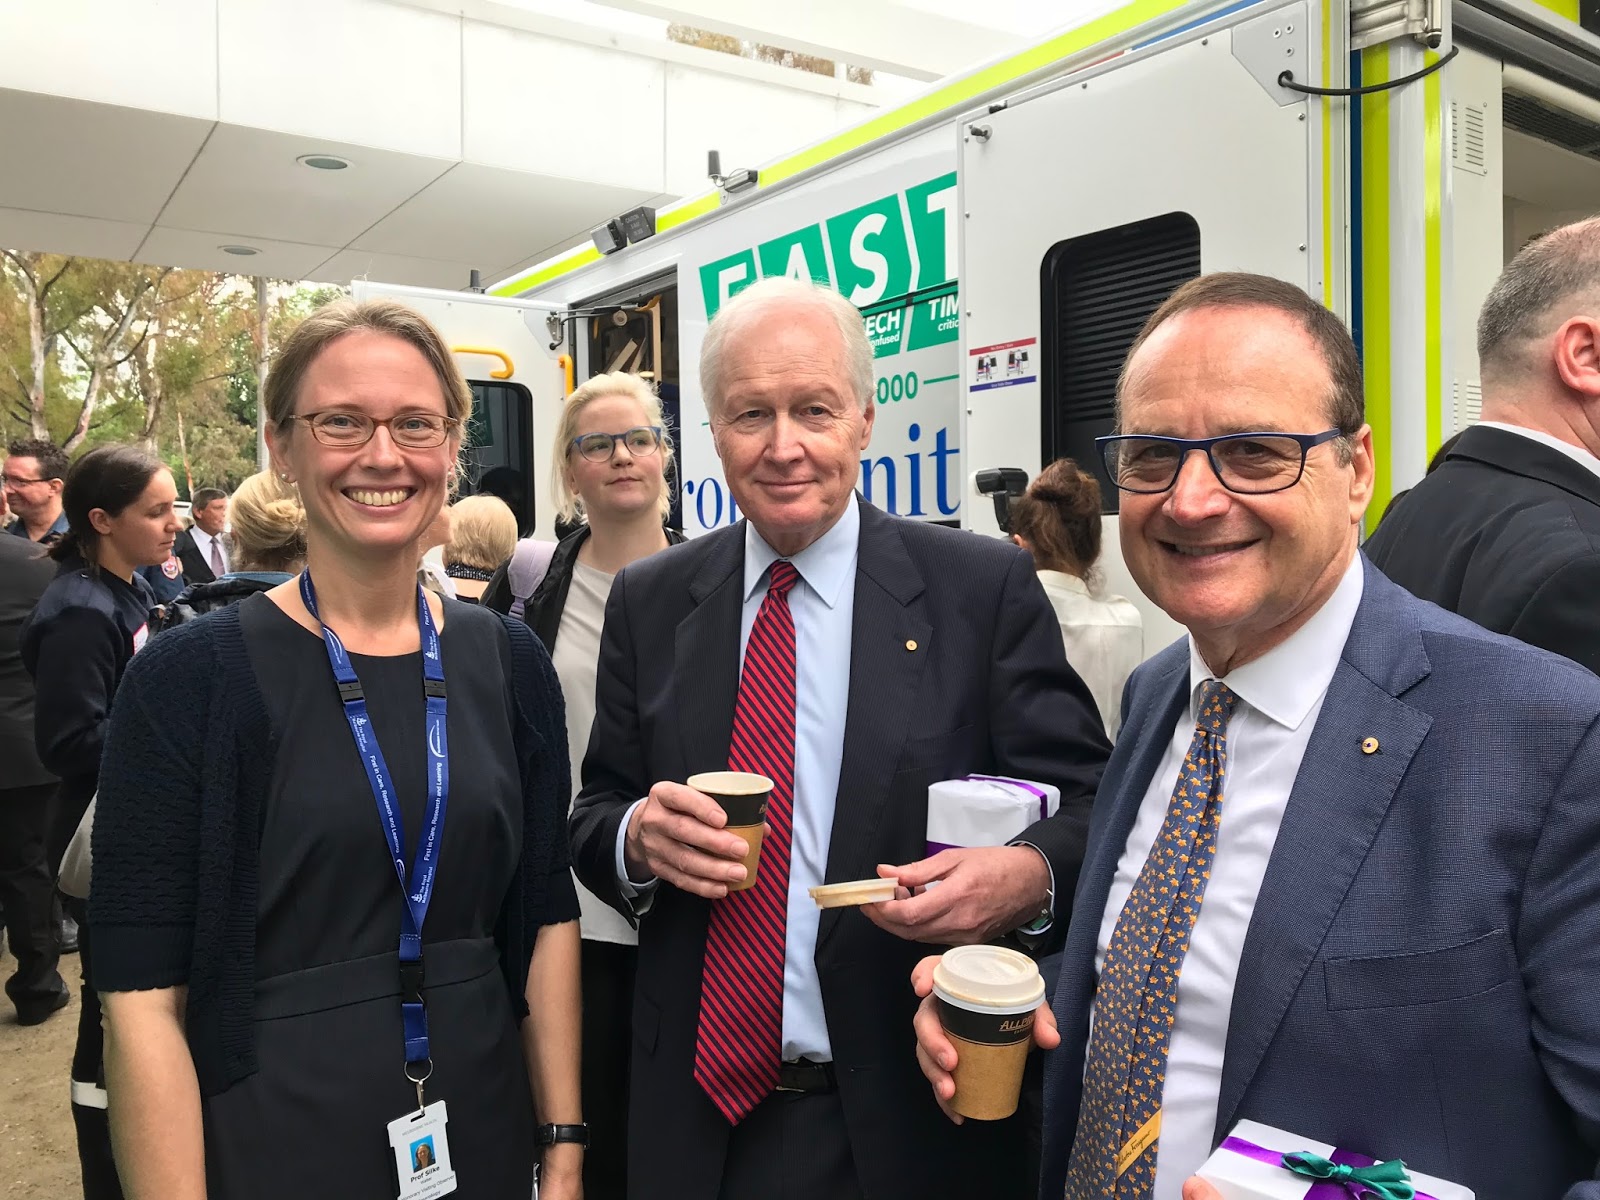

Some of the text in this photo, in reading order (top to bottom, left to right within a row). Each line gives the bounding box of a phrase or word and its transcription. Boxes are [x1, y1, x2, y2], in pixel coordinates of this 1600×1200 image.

[863, 309, 900, 337] ECH
[877, 371, 918, 404] 000
[369, 755, 378, 768] First
[381, 790, 394, 816] Research
[388, 817, 396, 828] and
[410, 1166, 440, 1183] Prof Silke
